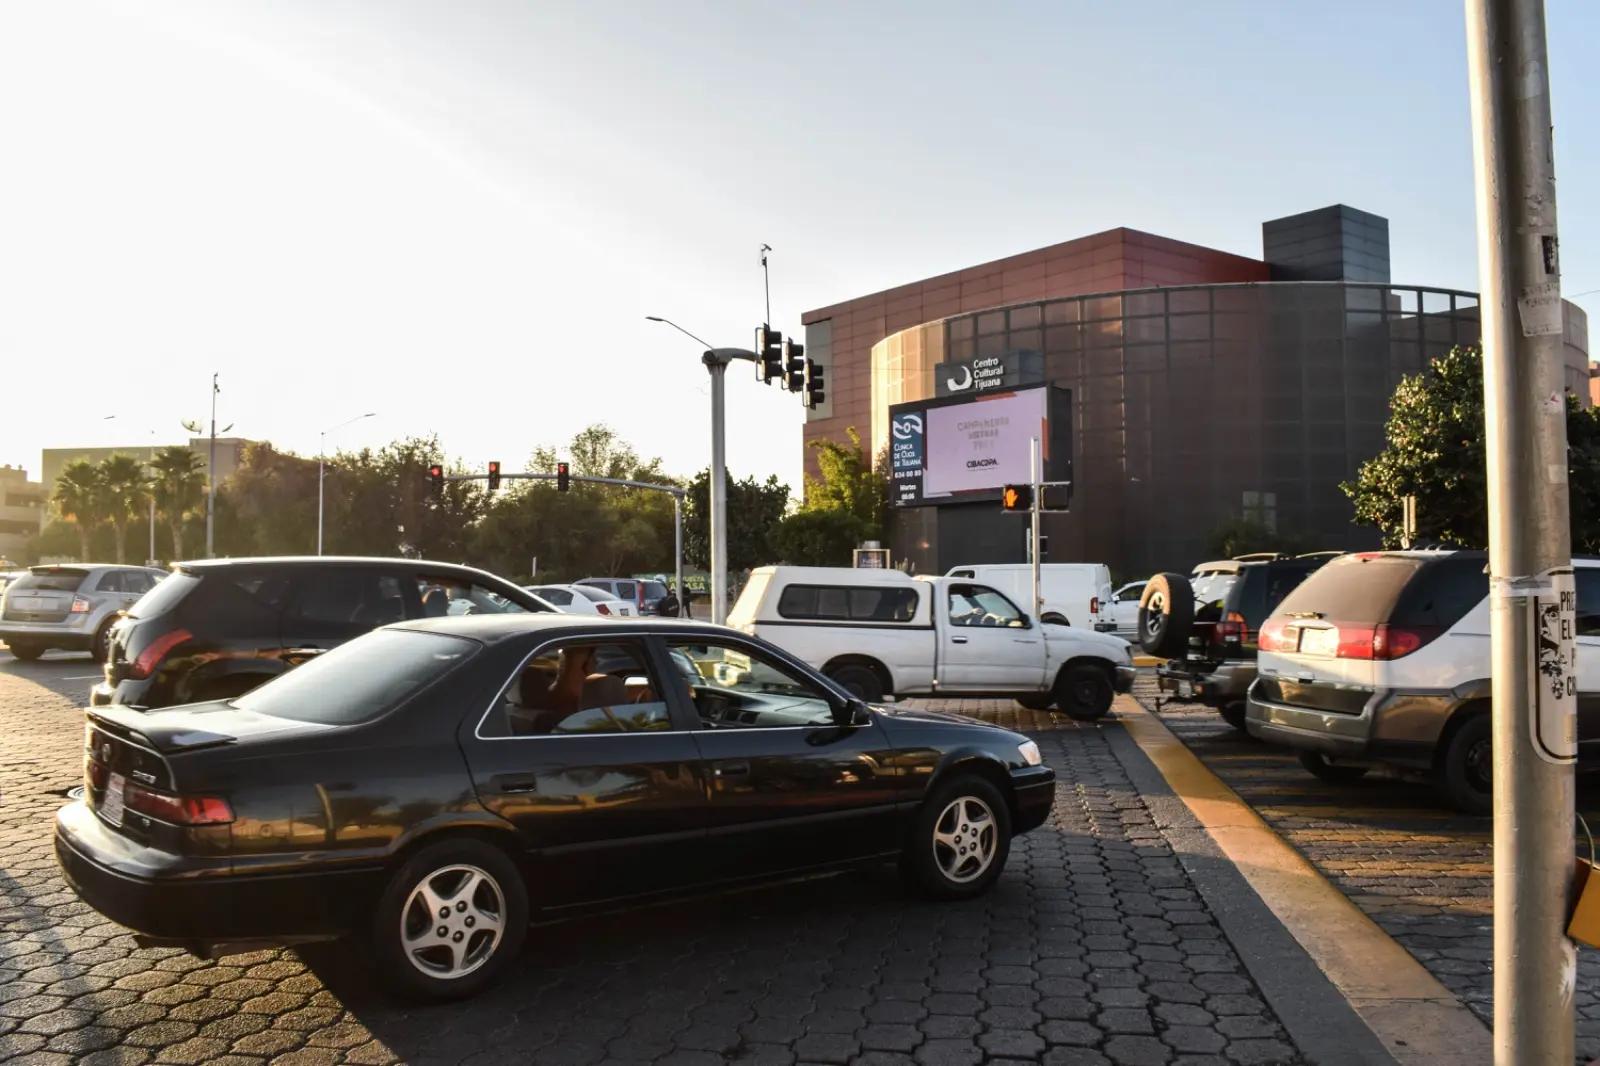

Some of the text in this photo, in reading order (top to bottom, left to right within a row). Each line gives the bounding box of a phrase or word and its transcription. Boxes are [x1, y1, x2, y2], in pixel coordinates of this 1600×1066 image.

[974, 357, 998, 368] Centro
[974, 366, 1003, 379] Cultural
[974, 379, 1000, 389] Tijuana
